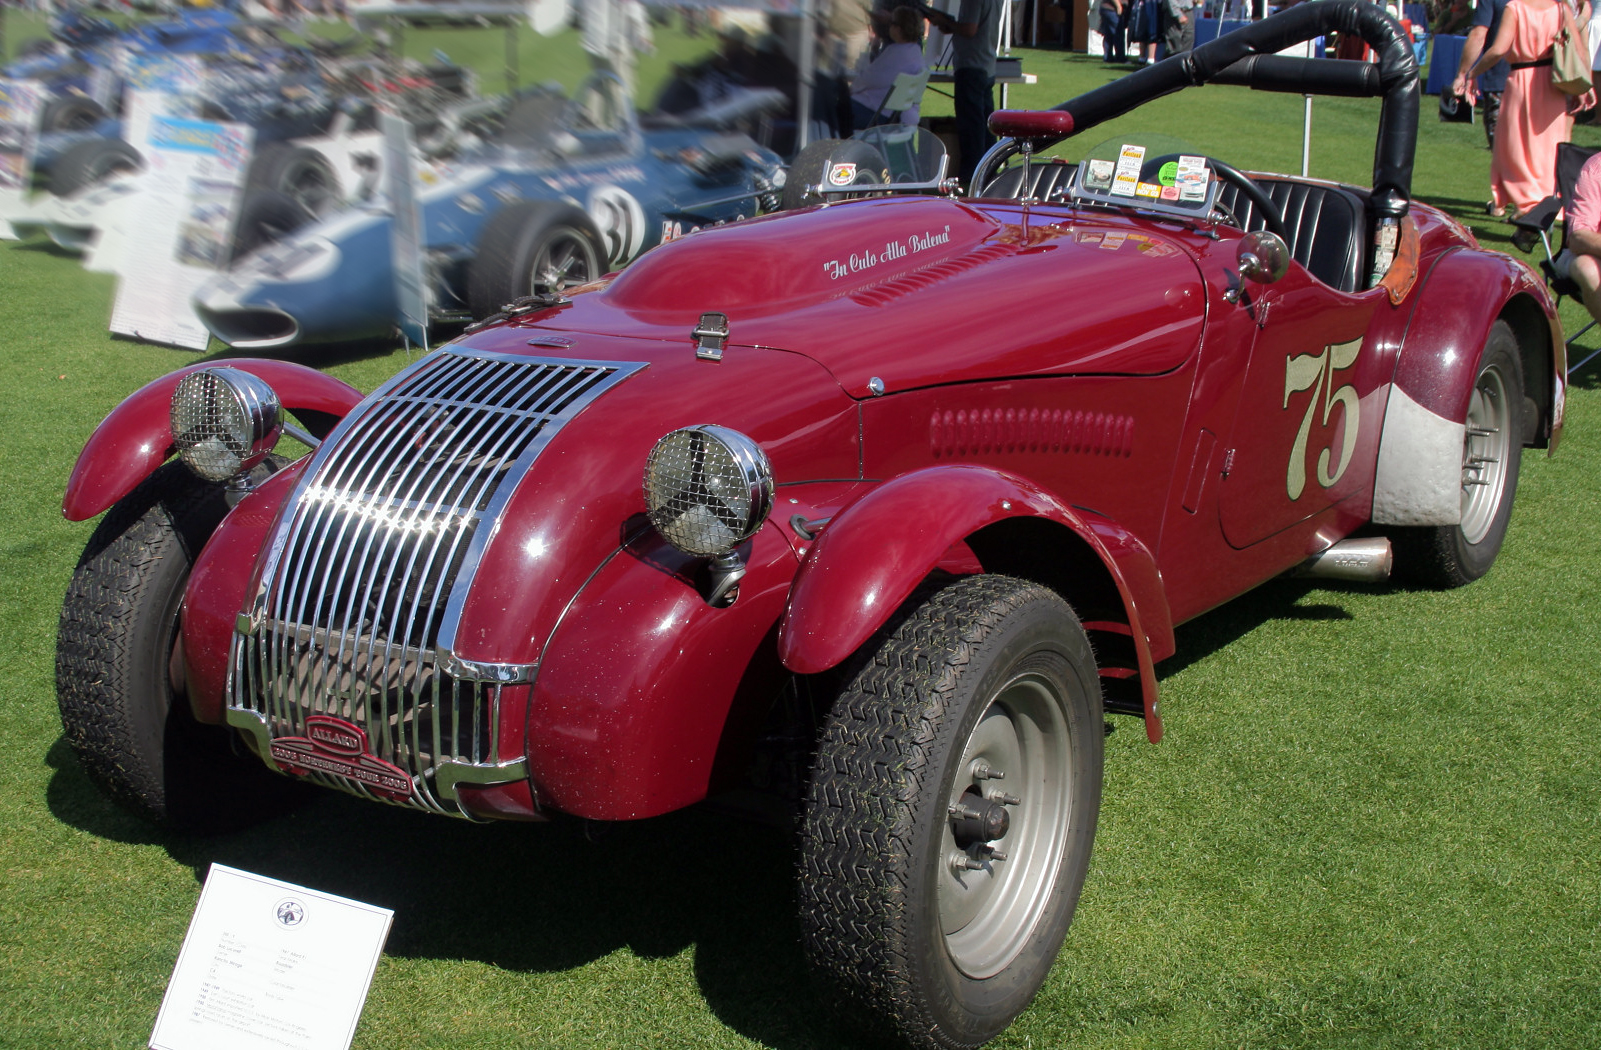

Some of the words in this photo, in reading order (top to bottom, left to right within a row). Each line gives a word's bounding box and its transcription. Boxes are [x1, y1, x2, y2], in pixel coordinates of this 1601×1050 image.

[597, 192, 632, 265] 31
[823, 260, 848, 280] "In
[849, 250, 878, 272] Culo
[880, 241, 907, 263] Alla
[908, 225, 950, 253] Balena"
[1283, 335, 1364, 502] 75
[312, 728, 358, 749] ALLARD
[354, 769, 379, 782] TOUR
